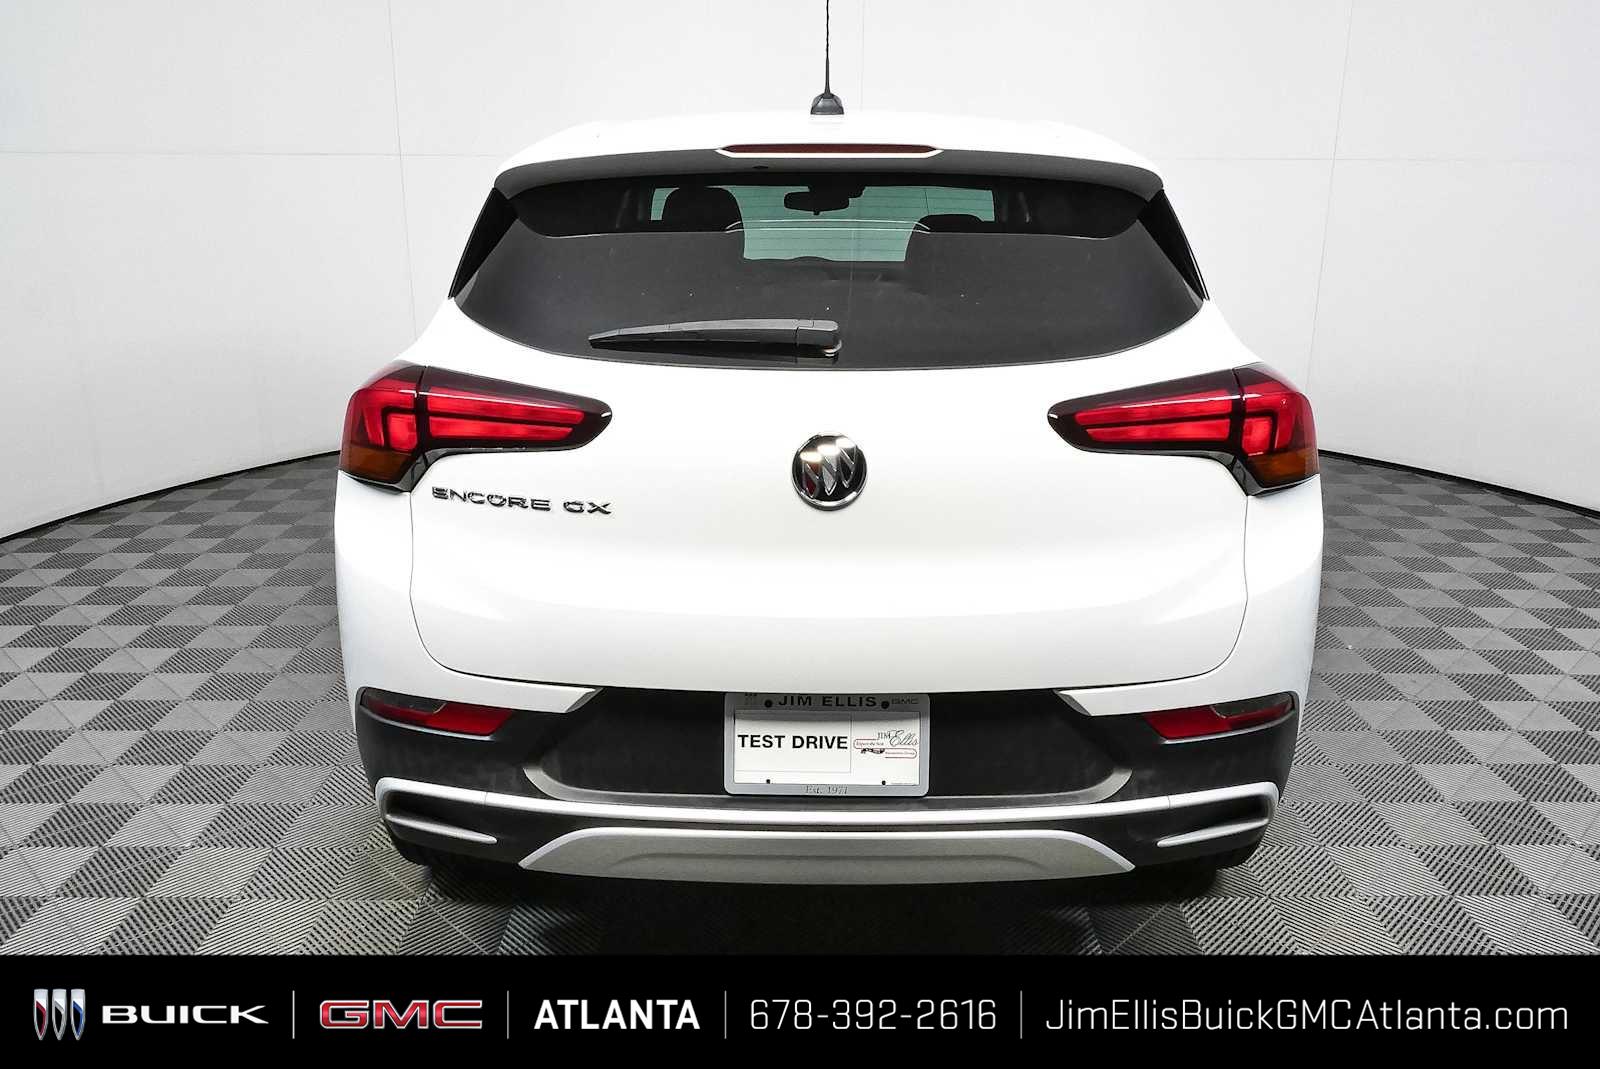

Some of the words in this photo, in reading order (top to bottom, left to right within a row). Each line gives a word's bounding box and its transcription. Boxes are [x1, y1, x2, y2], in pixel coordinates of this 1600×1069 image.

[432, 486, 551, 512] ENCORE
[562, 500, 612, 515] GX
[778, 695, 812, 707] JIM
[822, 696, 877, 708] ELLIS
[737, 734, 786, 749] TEST
[792, 735, 848, 749] DRIVE
[889, 729, 919, 747] Ellis
[805, 785, 826, 794] Est.
